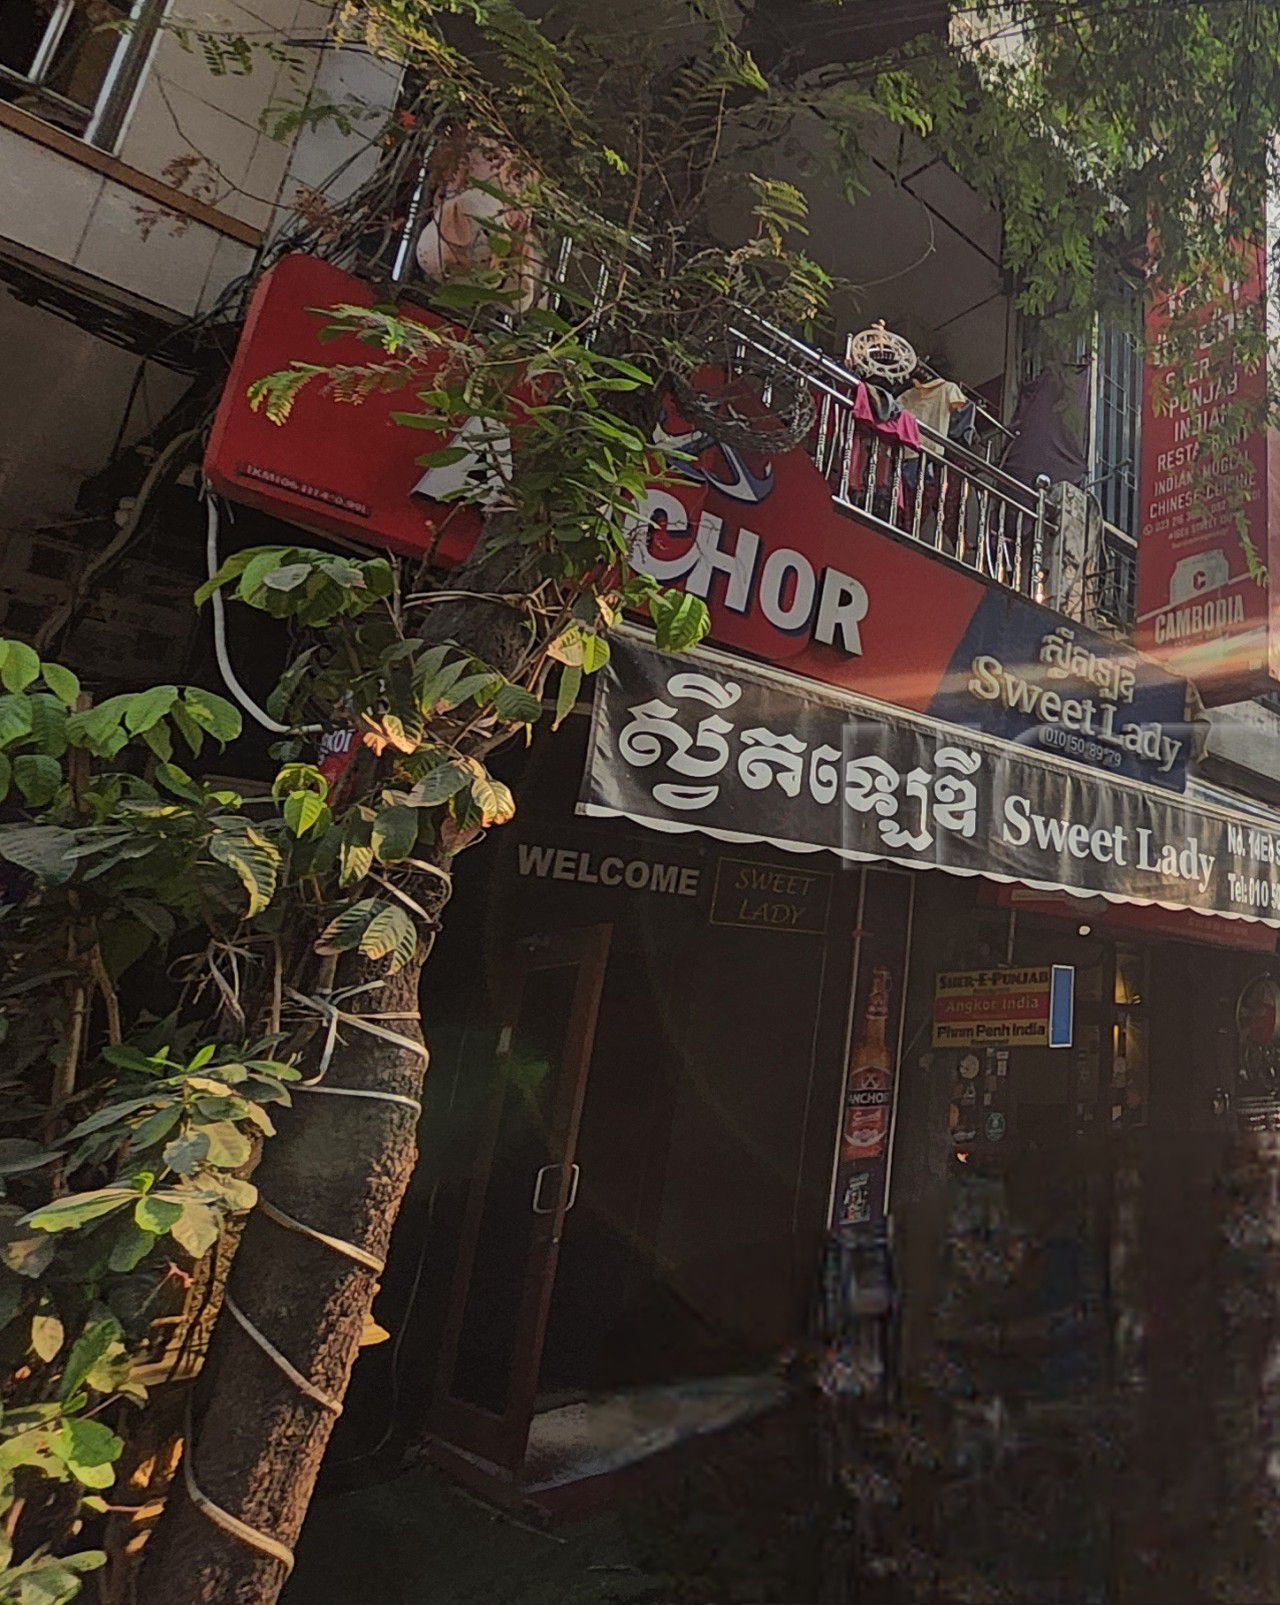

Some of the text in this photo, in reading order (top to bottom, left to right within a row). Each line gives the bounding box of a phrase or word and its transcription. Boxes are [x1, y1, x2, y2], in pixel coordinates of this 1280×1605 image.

[1157, 428, 1248, 473] RESTARNT
[1150, 489, 1199, 519] CHINESE
[410, 414, 870, 656] ACHOR
[1154, 594, 1245, 645] CAMBODIA
[968, 655, 1183, 773] Sweet Lady
[1002, 793, 1217, 894] Sweet Lady
[517, 844, 701, 898] WELCOME
[735, 868, 816, 897] SWEET
[1249, 877, 1269, 907] 010
[738, 898, 806, 926] LADY
[944, 995, 1040, 1014] Angkor India
[1012, 1022, 1046, 1036] India
